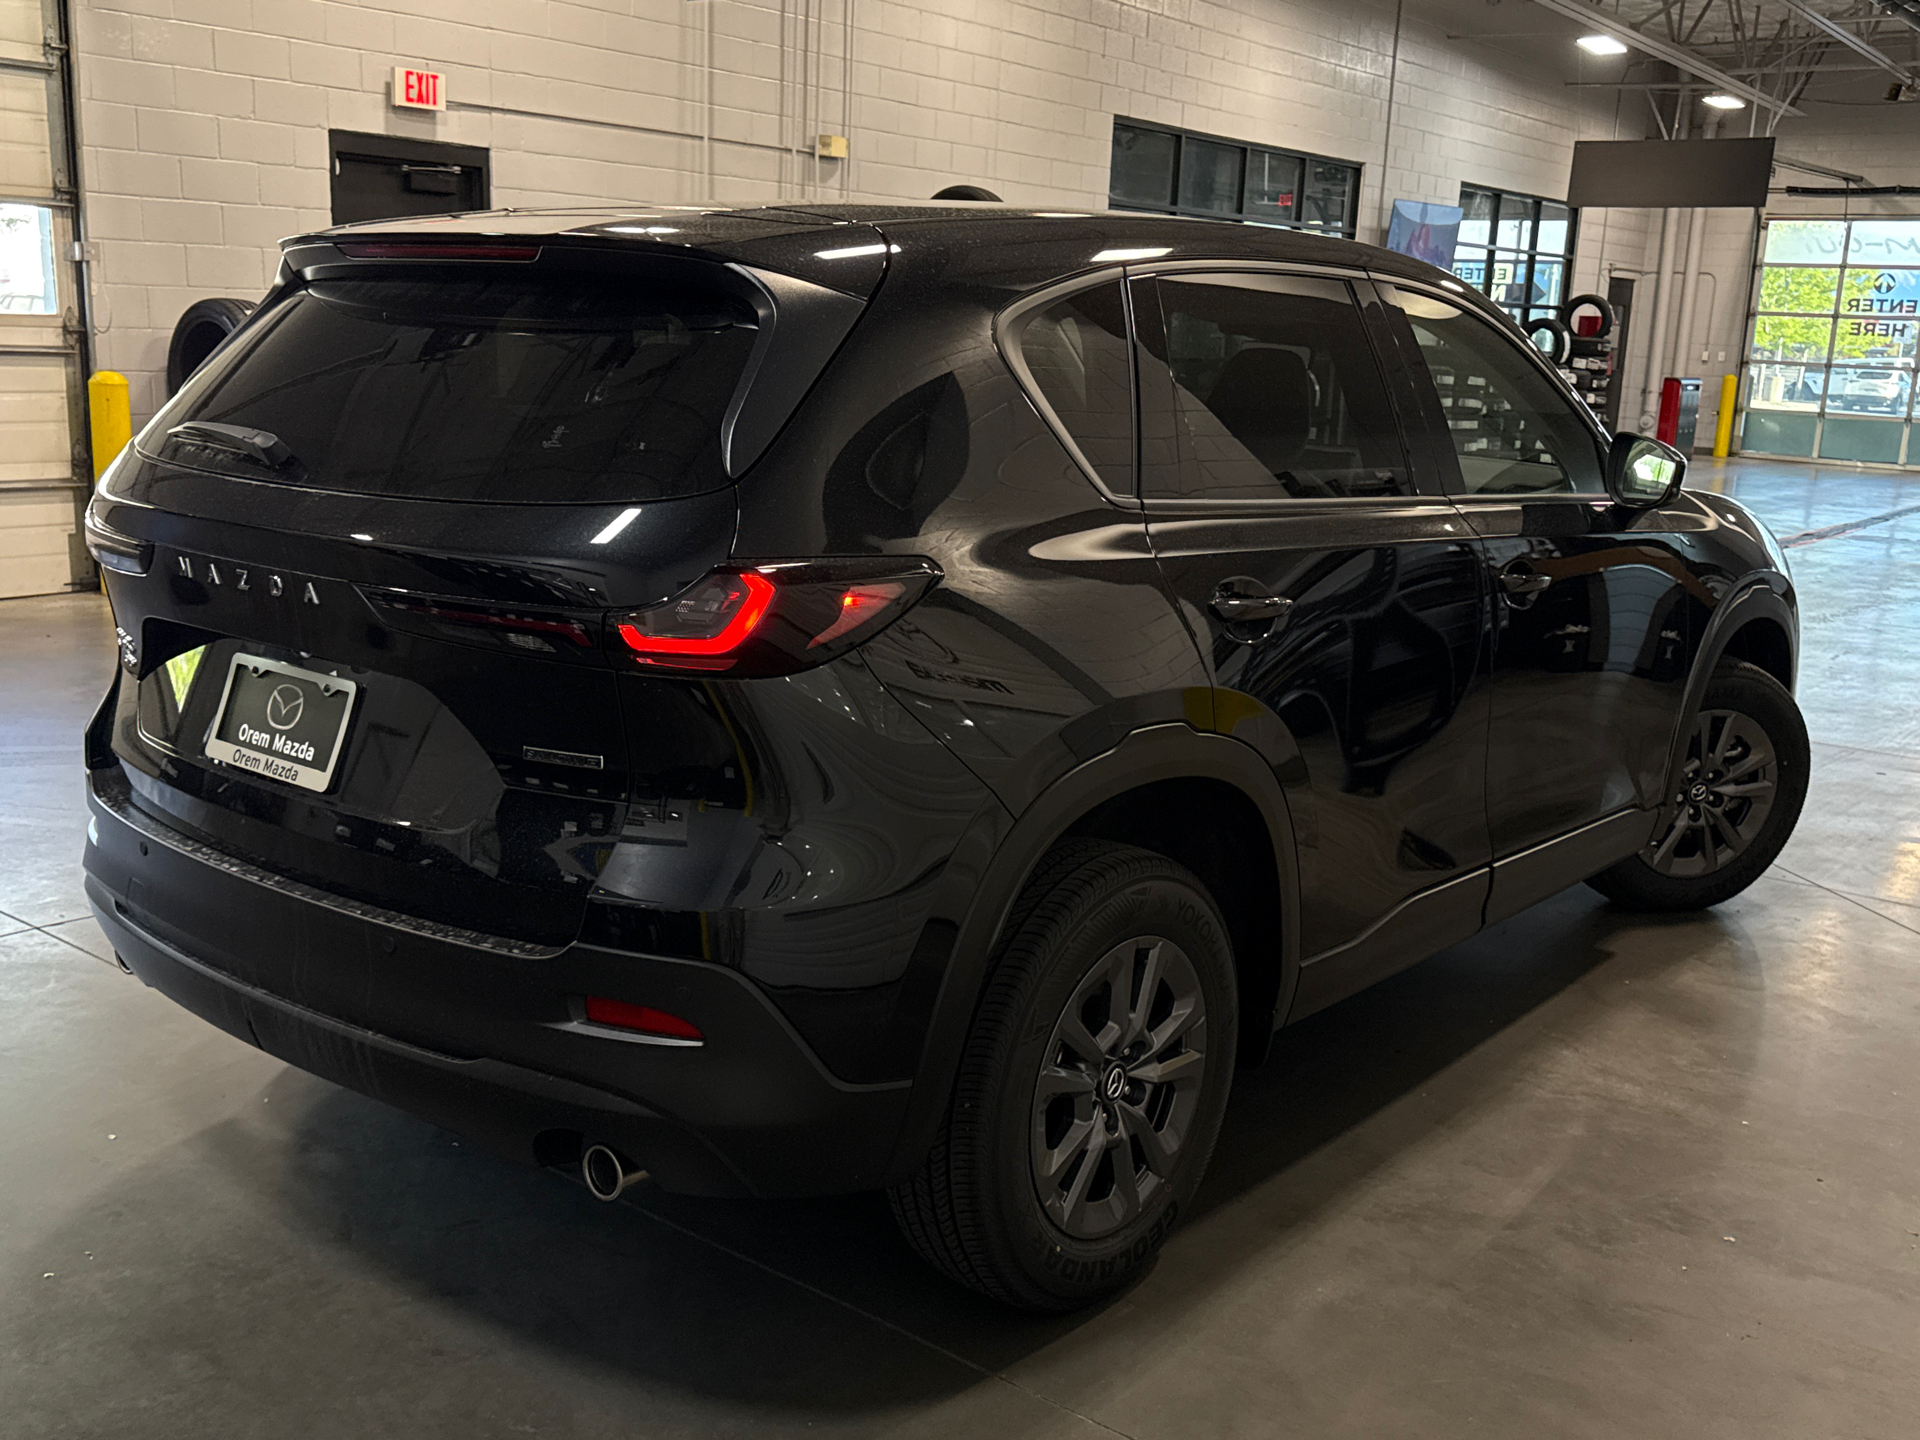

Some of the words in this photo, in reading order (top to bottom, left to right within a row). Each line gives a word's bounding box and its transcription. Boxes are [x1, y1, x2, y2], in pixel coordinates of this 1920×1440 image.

[404, 69, 440, 107] EXIT
[177, 554, 321, 606] MAZDA
[238, 723, 271, 749] Orem
[272, 732, 315, 762] Mazda
[232, 748, 261, 771] Orem
[262, 757, 299, 782] Mazda
